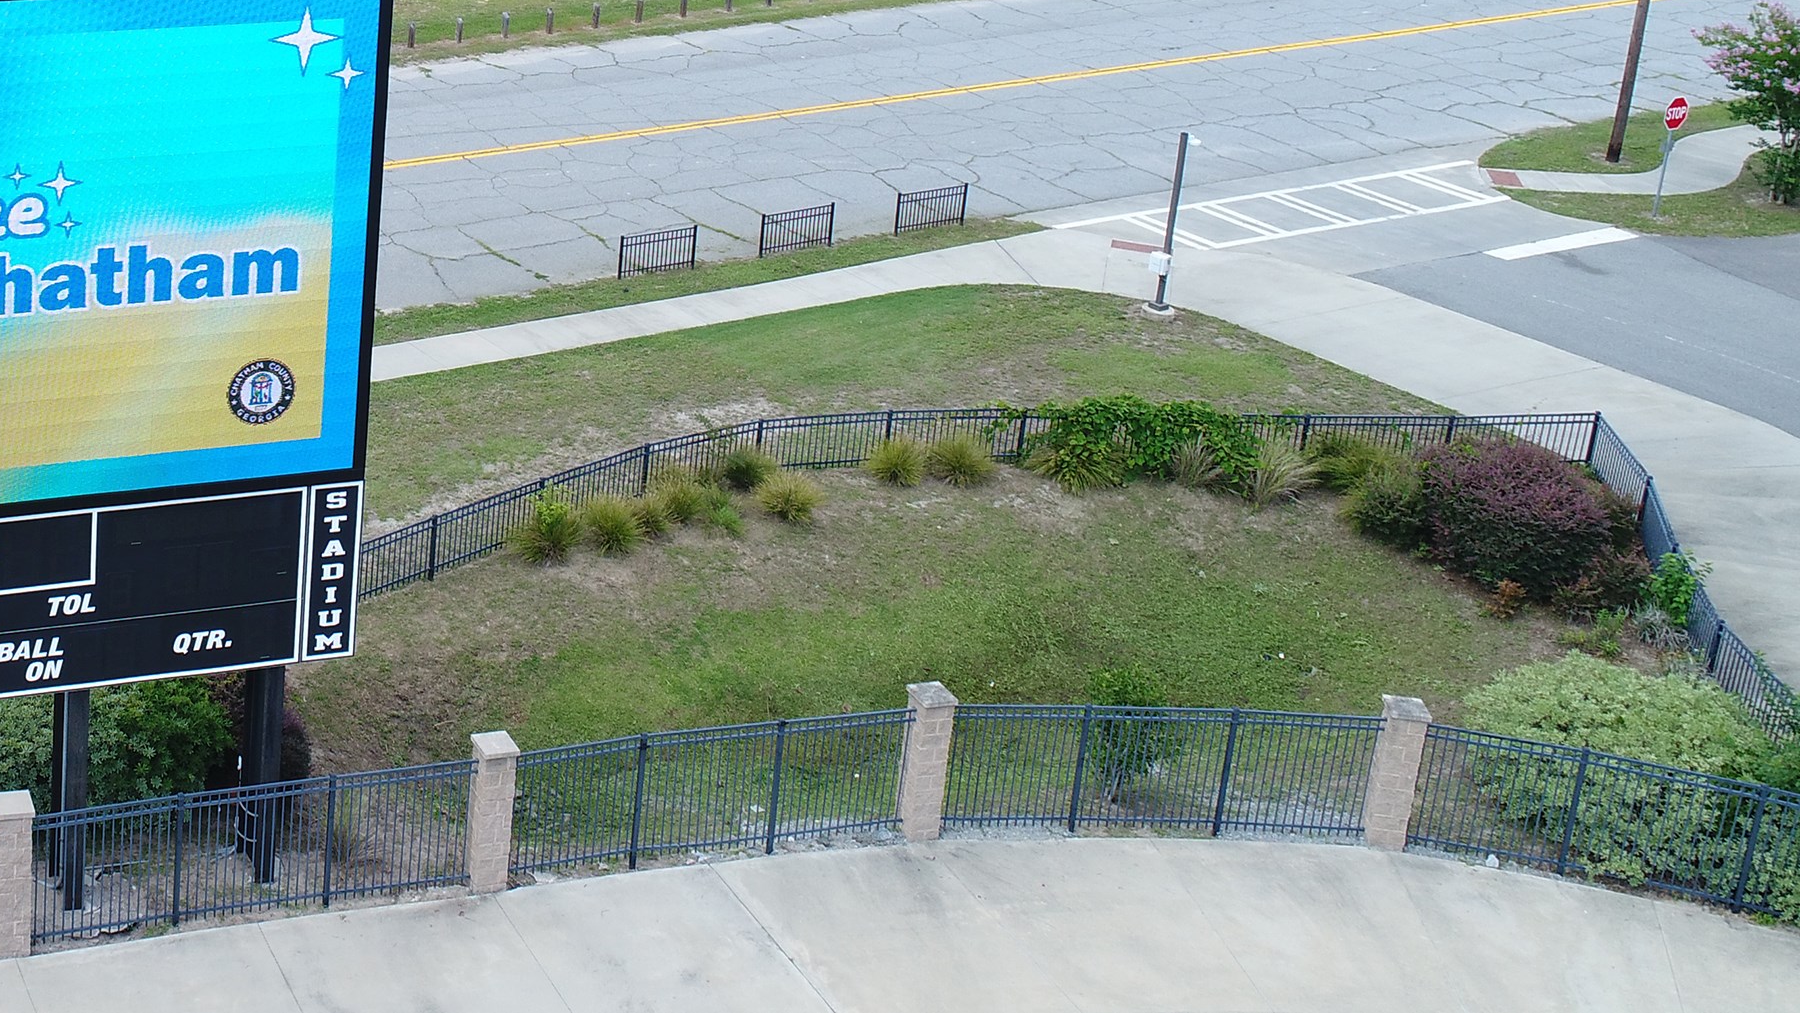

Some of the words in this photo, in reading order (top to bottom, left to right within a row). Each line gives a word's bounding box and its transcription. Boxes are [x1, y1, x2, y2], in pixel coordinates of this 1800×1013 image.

[1666, 106, 1687, 121] STOP
[230, 362, 264, 396] CHATHAM
[268, 362, 293, 391] COUNTY
[236, 405, 285, 423] GEORGIA
[314, 491, 348, 652] STADIUM
[47, 593, 96, 617] TOL
[172, 630, 233, 655] QTR.
[25, 659, 64, 682] ON
